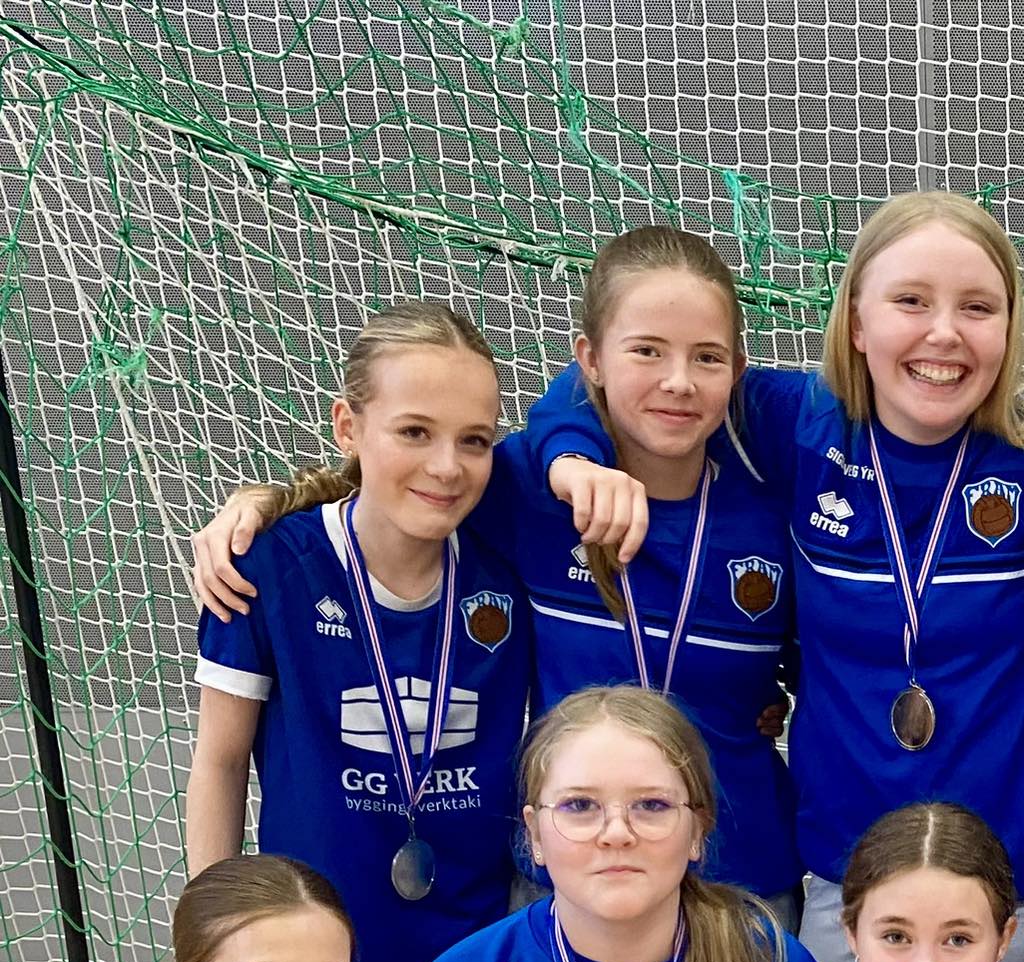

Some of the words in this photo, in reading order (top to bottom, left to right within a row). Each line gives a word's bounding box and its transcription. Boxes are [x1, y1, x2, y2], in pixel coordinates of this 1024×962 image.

[809, 511, 850, 538] errea
[568, 566, 597, 584] err
[316, 620, 353, 640] errea
[341, 767, 388, 795] GG
[394, 766, 479, 794] ERK
[345, 795, 481, 815] byggingverktaki
